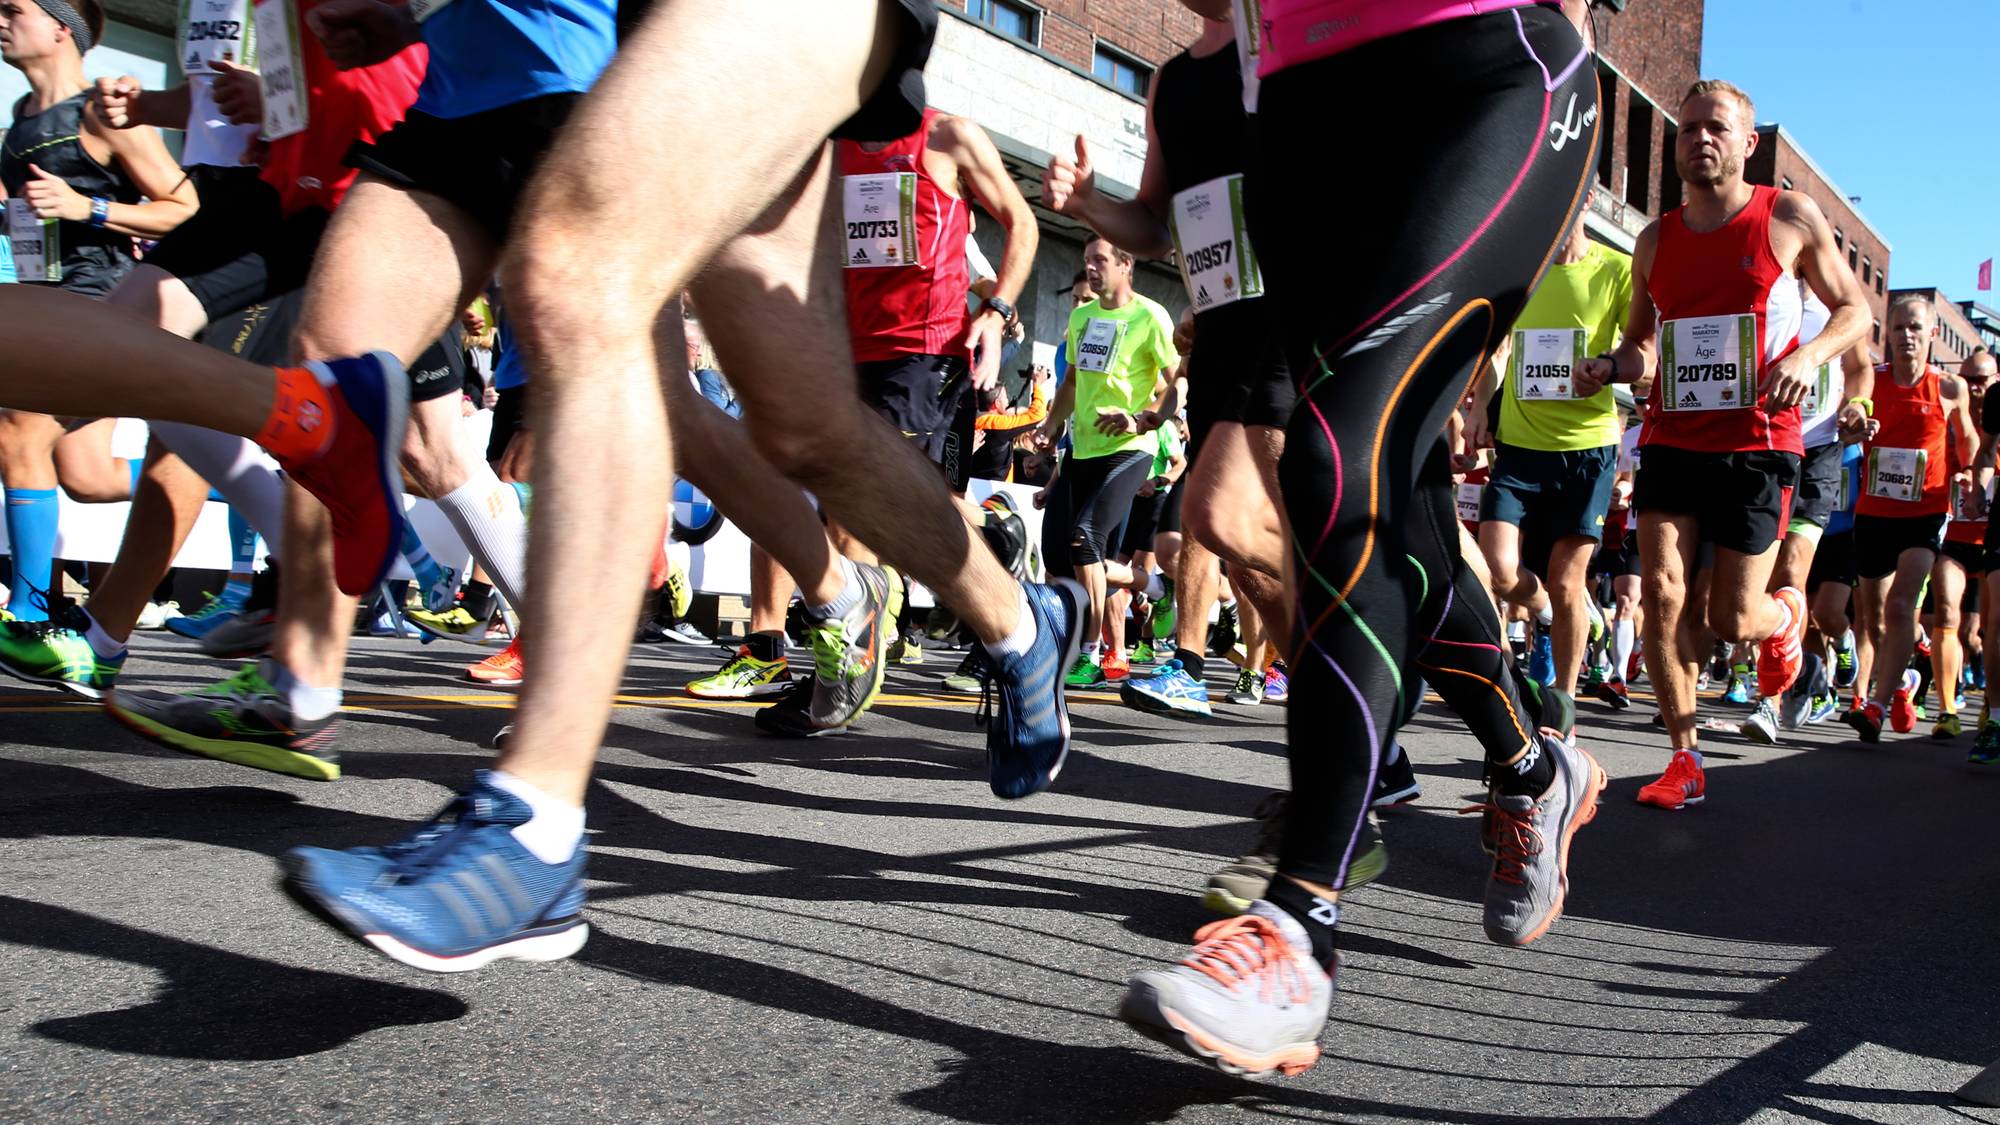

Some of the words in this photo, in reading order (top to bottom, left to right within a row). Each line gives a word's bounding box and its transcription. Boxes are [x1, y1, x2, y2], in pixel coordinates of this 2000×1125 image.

[189, 21, 240, 41] 20452
[847, 221, 898, 239] 20733
[1186, 239, 1233, 276] 20957
[1081, 343, 1108, 355] 20850
[1695, 344, 1717, 360] Åge
[1525, 364, 1571, 378] 21059
[1677, 363, 1737, 383] 20789
[945, 431, 960, 486] 2XU
[1878, 471, 1913, 486] 20682
